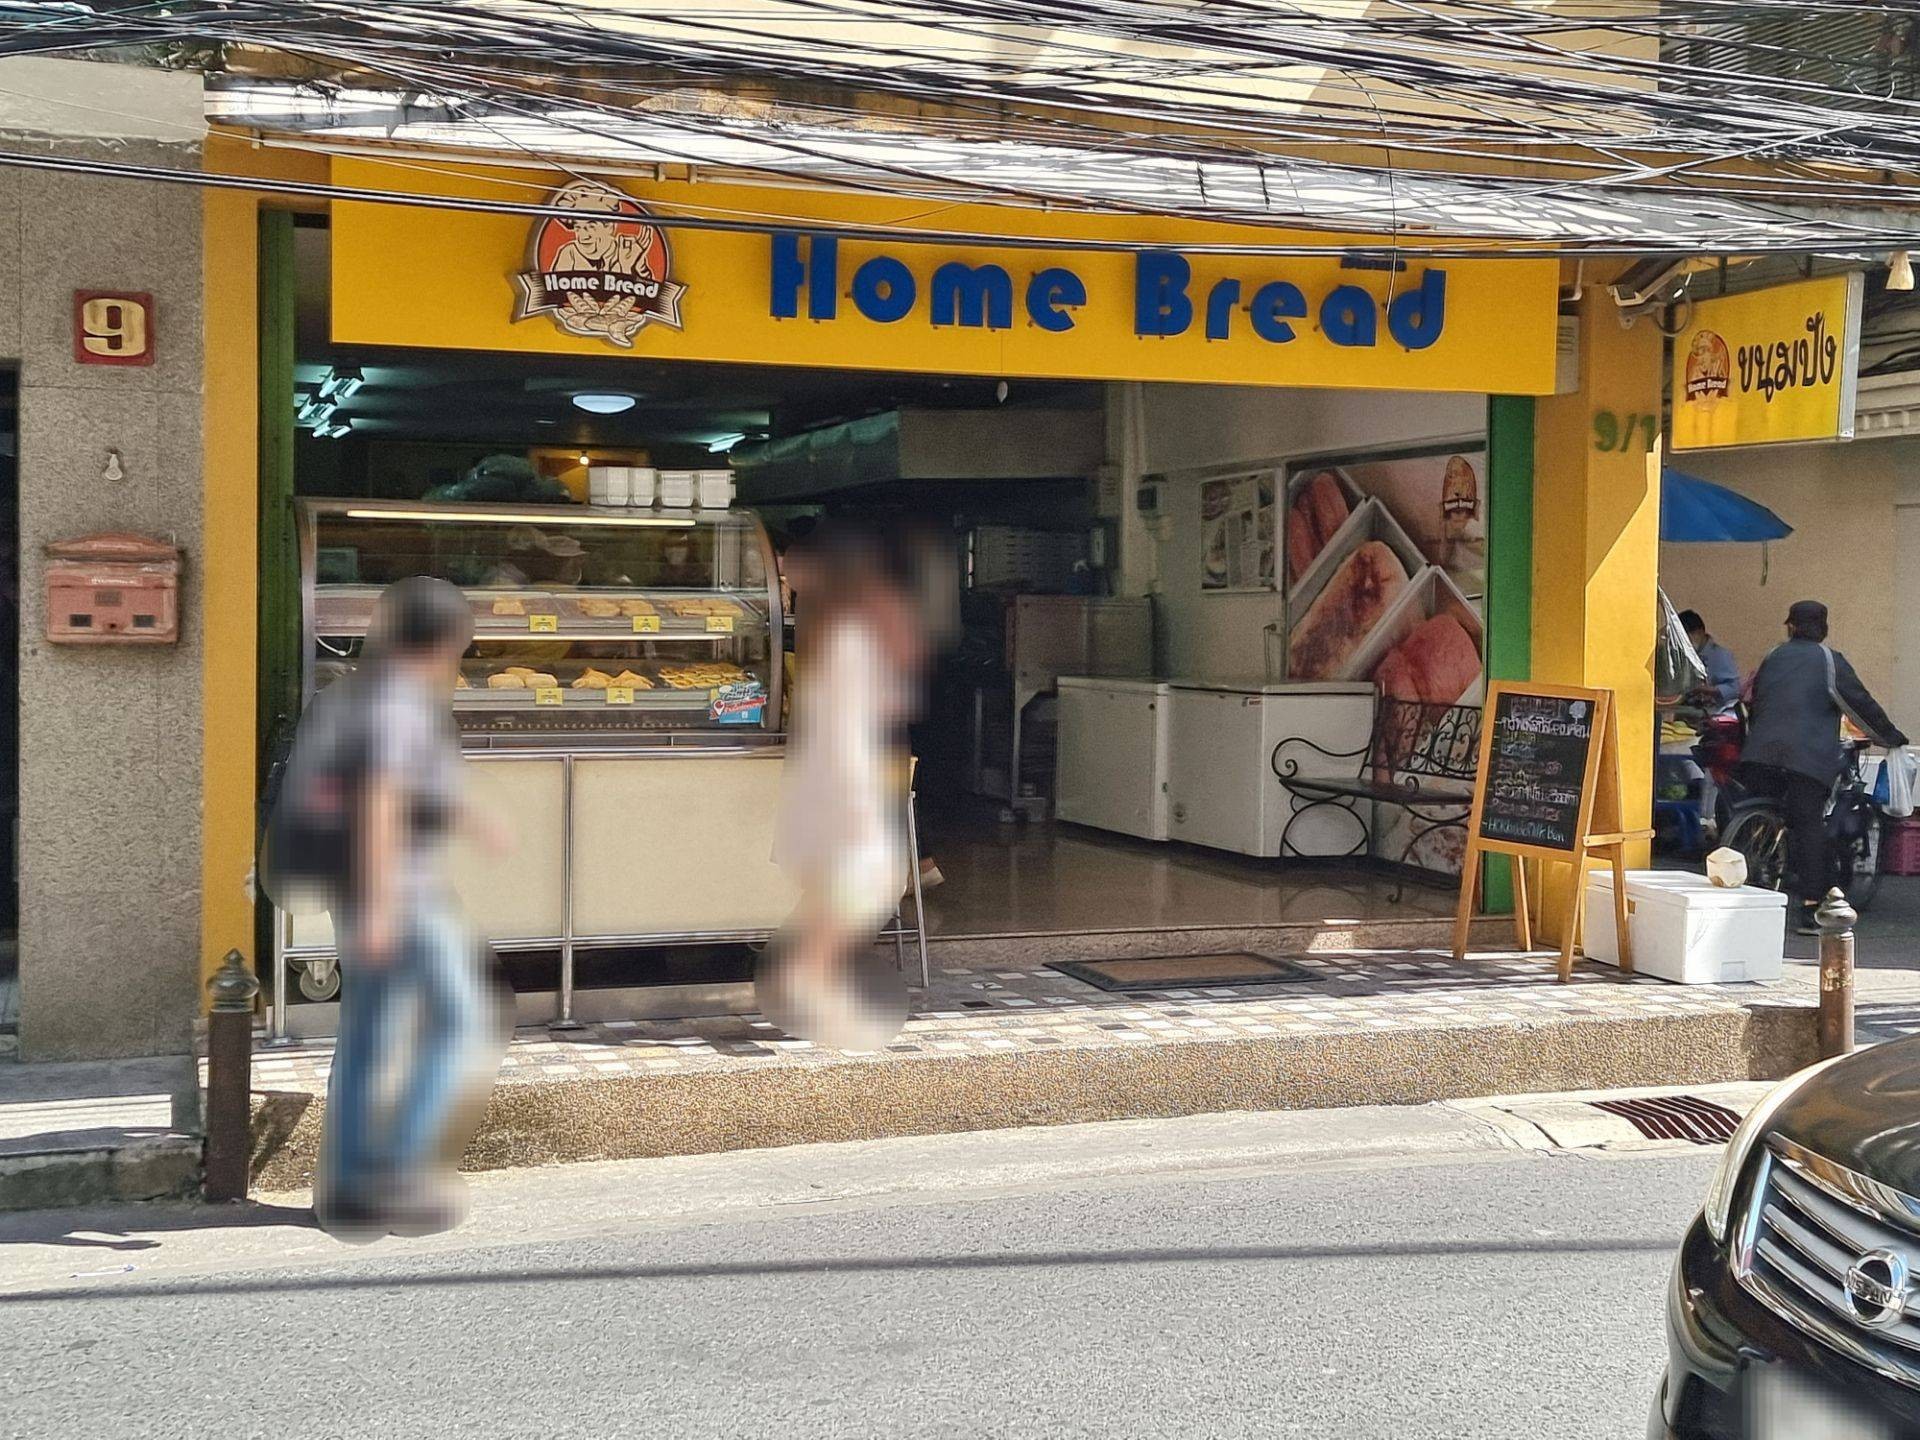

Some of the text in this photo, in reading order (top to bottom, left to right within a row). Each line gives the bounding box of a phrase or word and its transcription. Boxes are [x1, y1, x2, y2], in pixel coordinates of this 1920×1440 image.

[545, 274, 659, 299] Home Bread
[770, 231, 1447, 350] Home Bread
[82, 298, 147, 356] 9
[1738, 312, 1837, 403] ขนมปัง
[1594, 411, 1656, 452] 9/1
[1847, 1270, 1892, 1304] NISSAN
